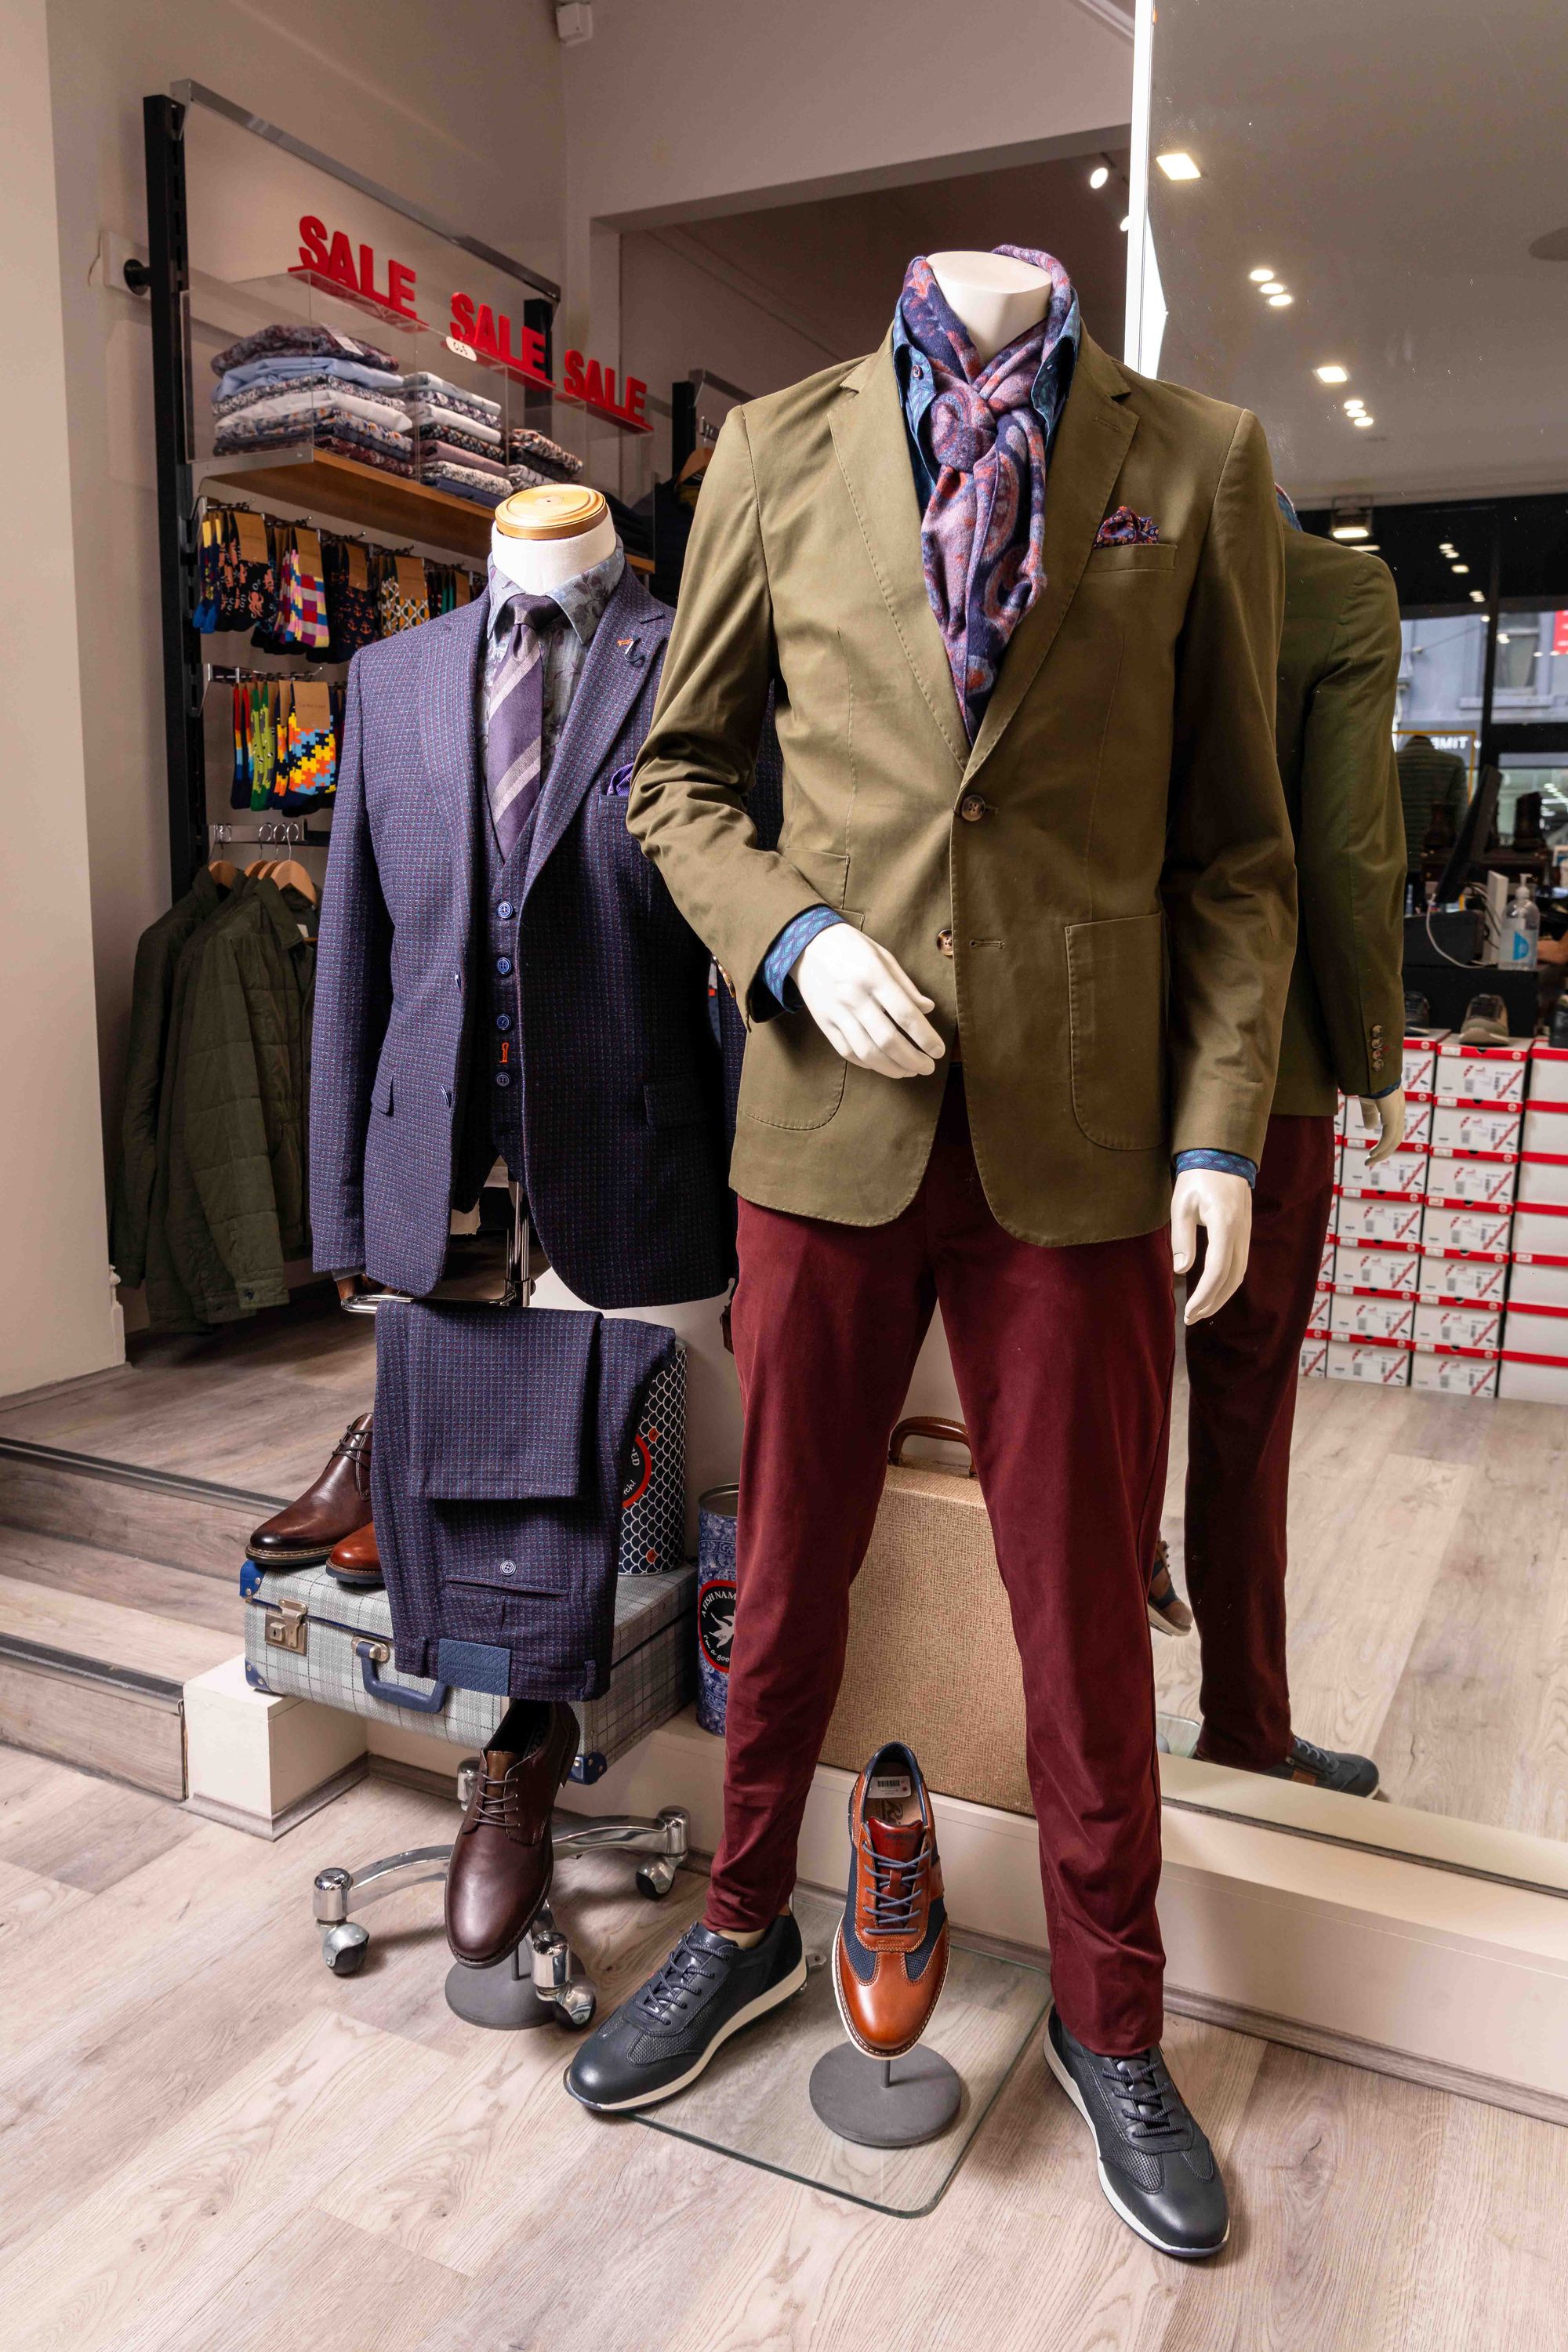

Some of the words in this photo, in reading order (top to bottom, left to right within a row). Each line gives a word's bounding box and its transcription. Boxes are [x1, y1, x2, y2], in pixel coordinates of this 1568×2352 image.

[299, 215, 417, 318] SALE
[450, 292, 546, 378] SALE
[564, 349, 647, 422] SALE
[630, 1447, 640, 1466] ED
[702, 1593, 715, 1610] FISH
[714, 1591, 736, 1600] NAM
